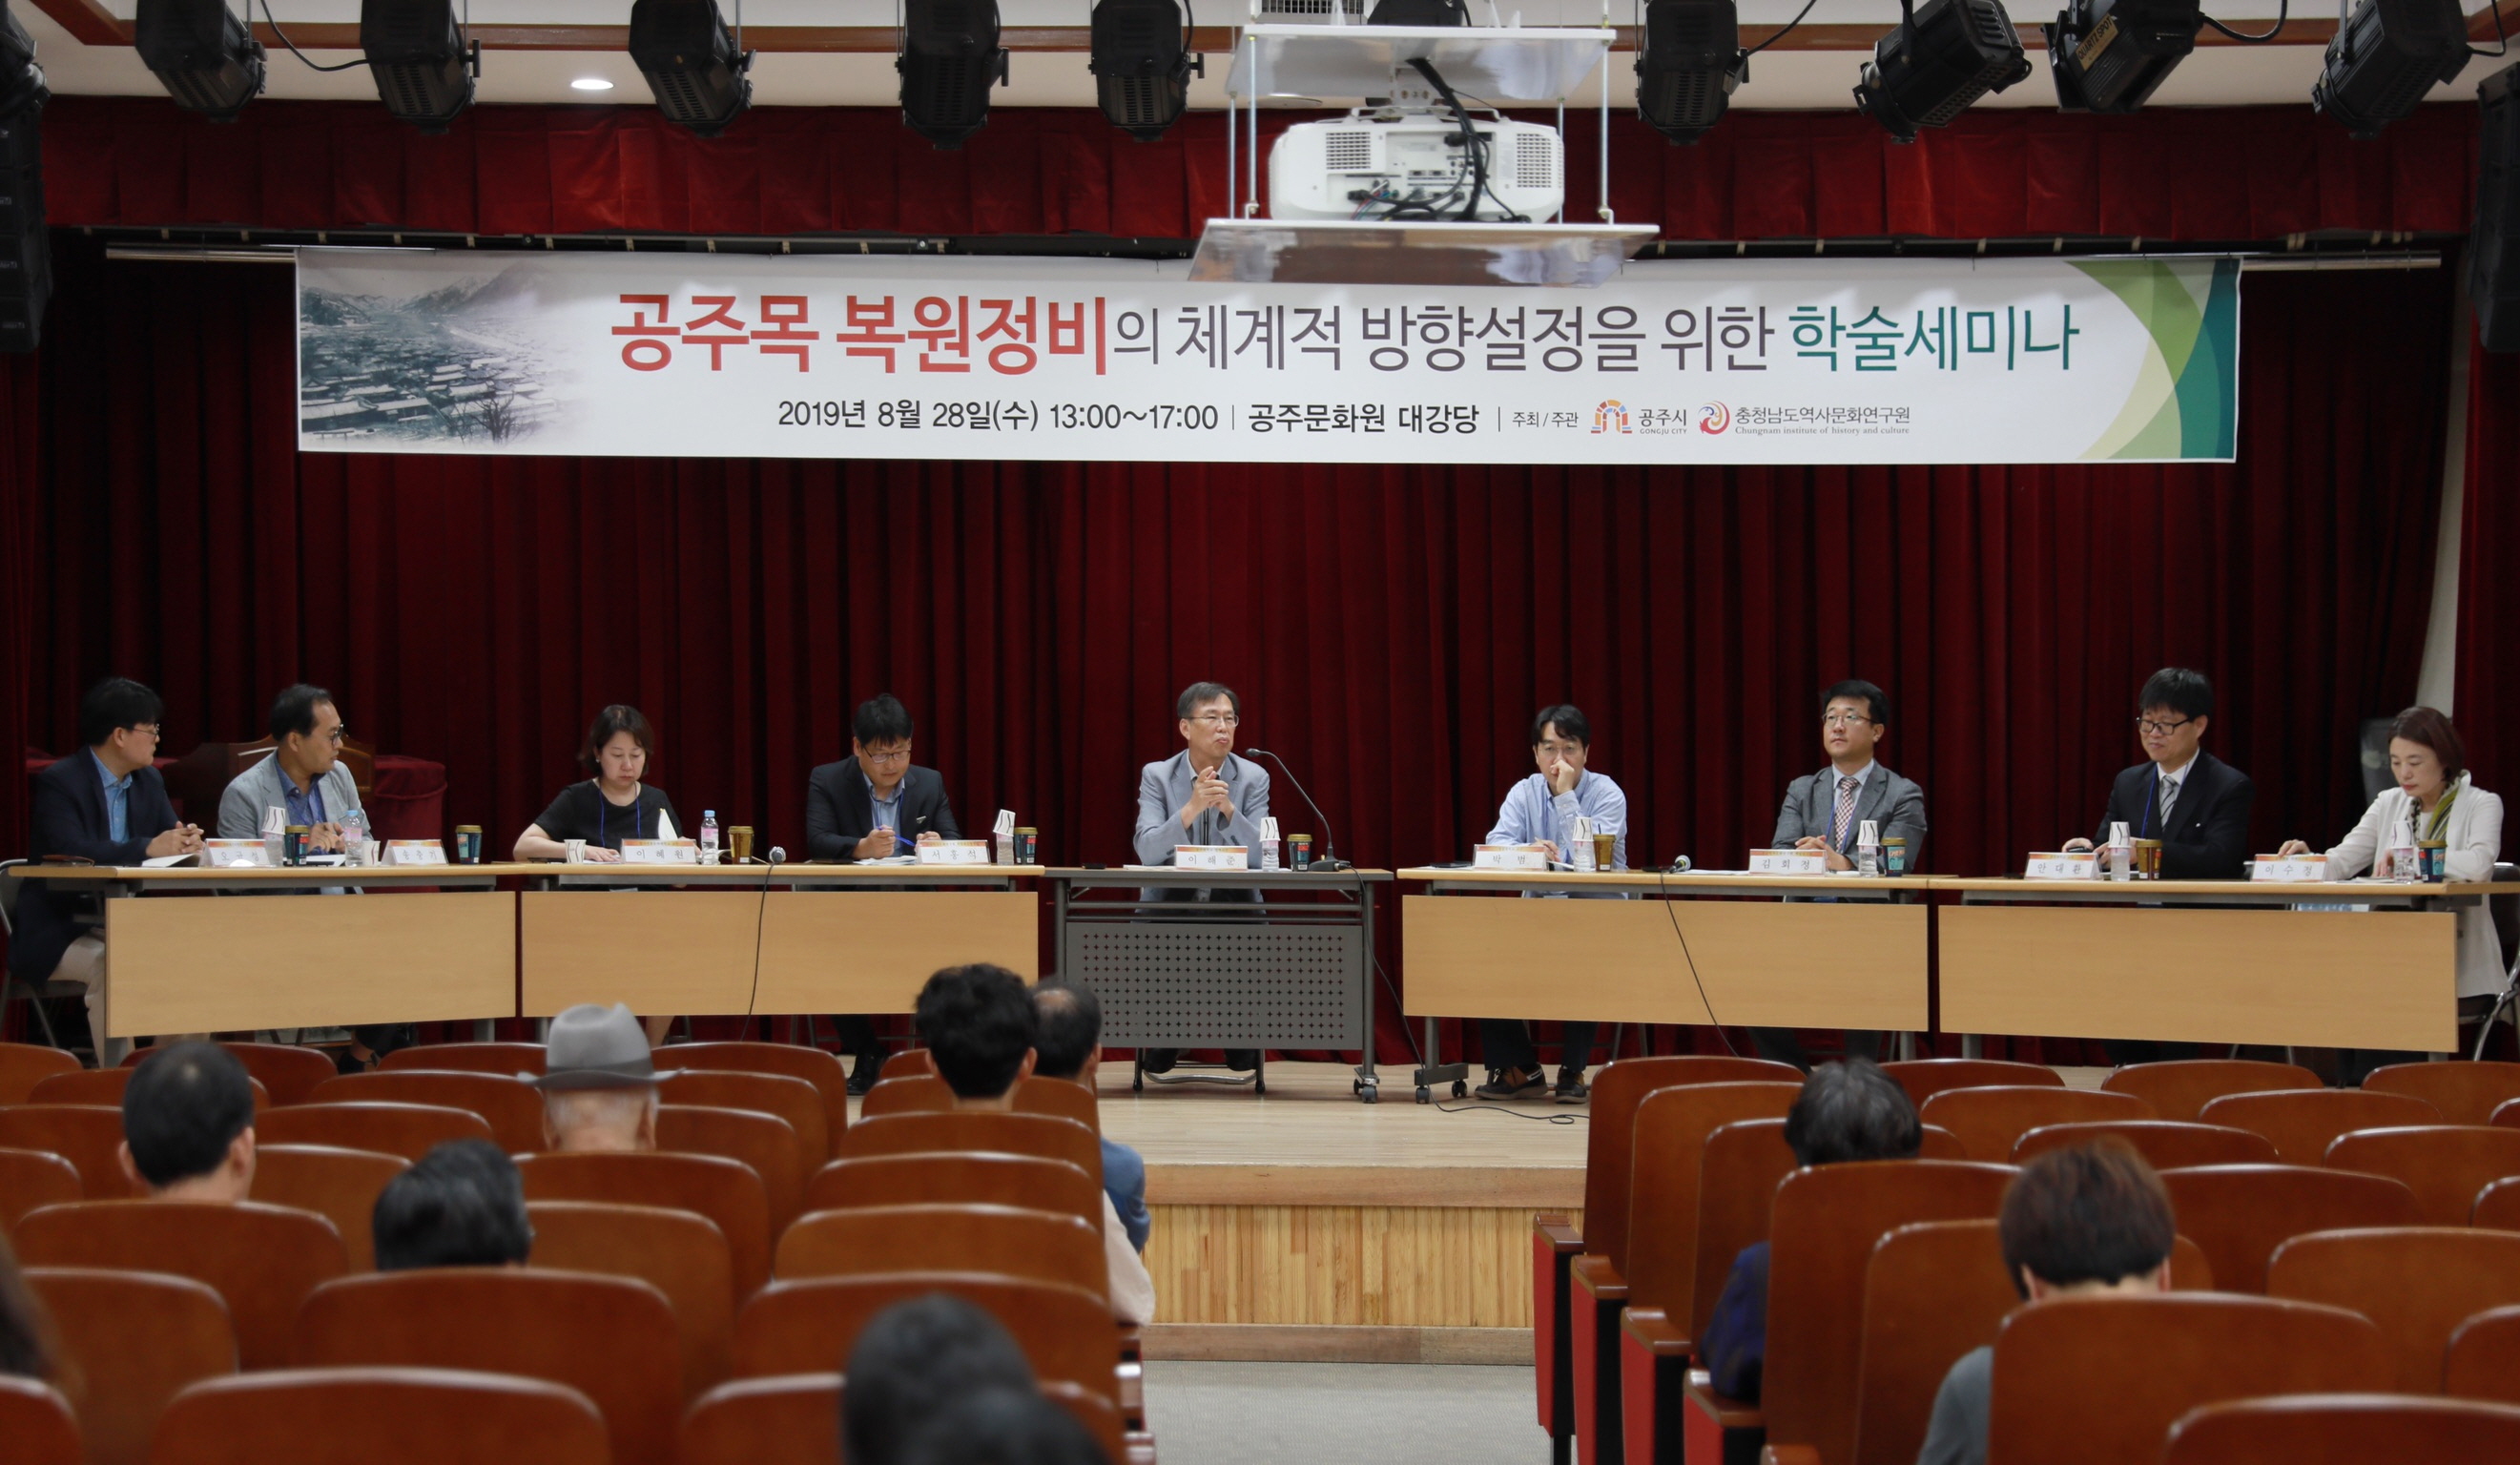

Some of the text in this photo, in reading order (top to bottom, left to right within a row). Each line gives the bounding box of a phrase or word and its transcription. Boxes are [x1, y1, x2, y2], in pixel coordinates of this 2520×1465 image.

[2078, 32, 2099, 60] QUARTZ
[2097, 17, 2113, 37] SPOT
[611, 293, 2080, 376] 공주목 복원정비의 체계적 방향설정을 위한 학술세미나
[778, 400, 866, 428] 2019년
[878, 399, 921, 429] 8월
[932, 400, 1039, 431] 28일(수)
[1049, 403, 1219, 430] 13:00~17:00
[1248, 403, 1386, 433] 공주문화원
[1398, 404, 1479, 434] 대강당
[1638, 408, 1687, 427] 공주시
[1734, 406, 1911, 424] 충청남도역사문화연구원
[1734, 426, 1782, 436] Chungnam
[1831, 426, 1860, 436] history
